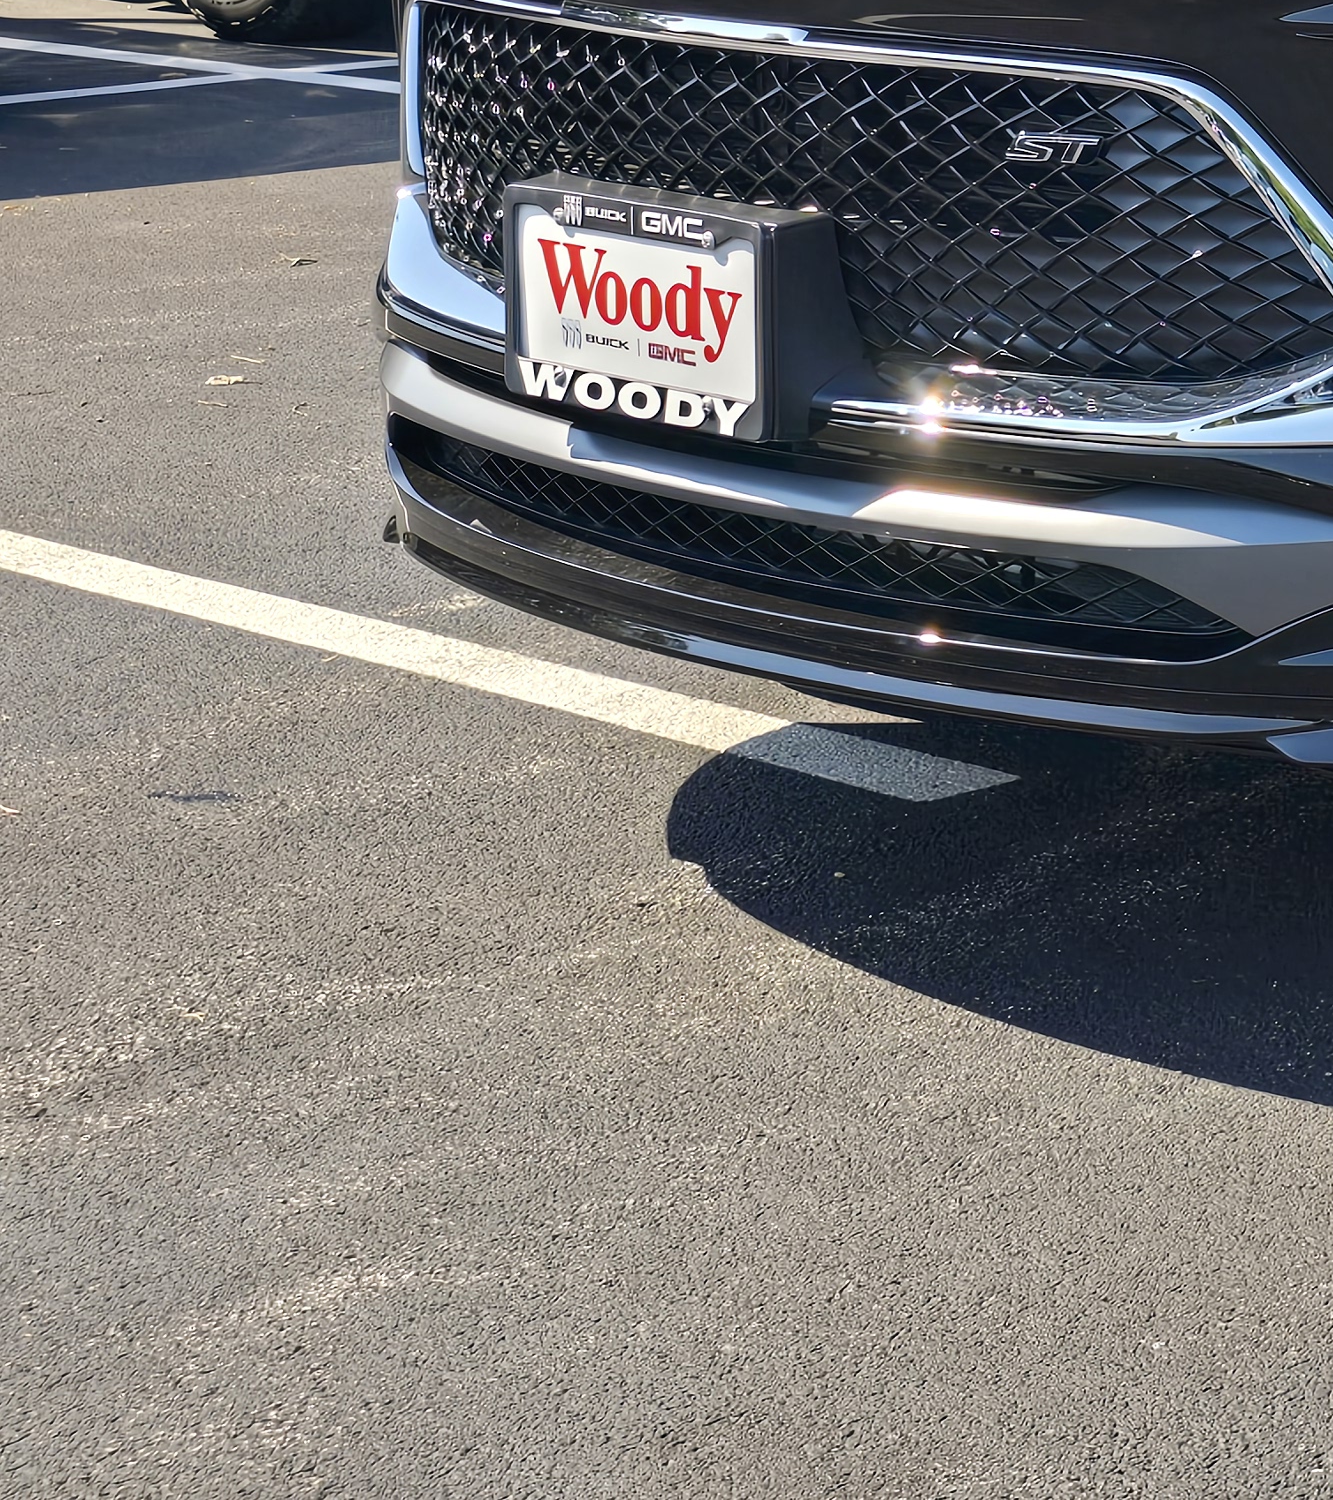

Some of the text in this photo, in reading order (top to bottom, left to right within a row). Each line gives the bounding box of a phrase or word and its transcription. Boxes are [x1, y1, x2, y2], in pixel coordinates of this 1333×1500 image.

[1004, 131, 1100, 165] ST
[585, 206, 704, 241] BUICK GMC
[537, 238, 743, 363] Woody
[585, 333, 697, 367] BUICK GMC
[518, 358, 750, 437] WOODY
